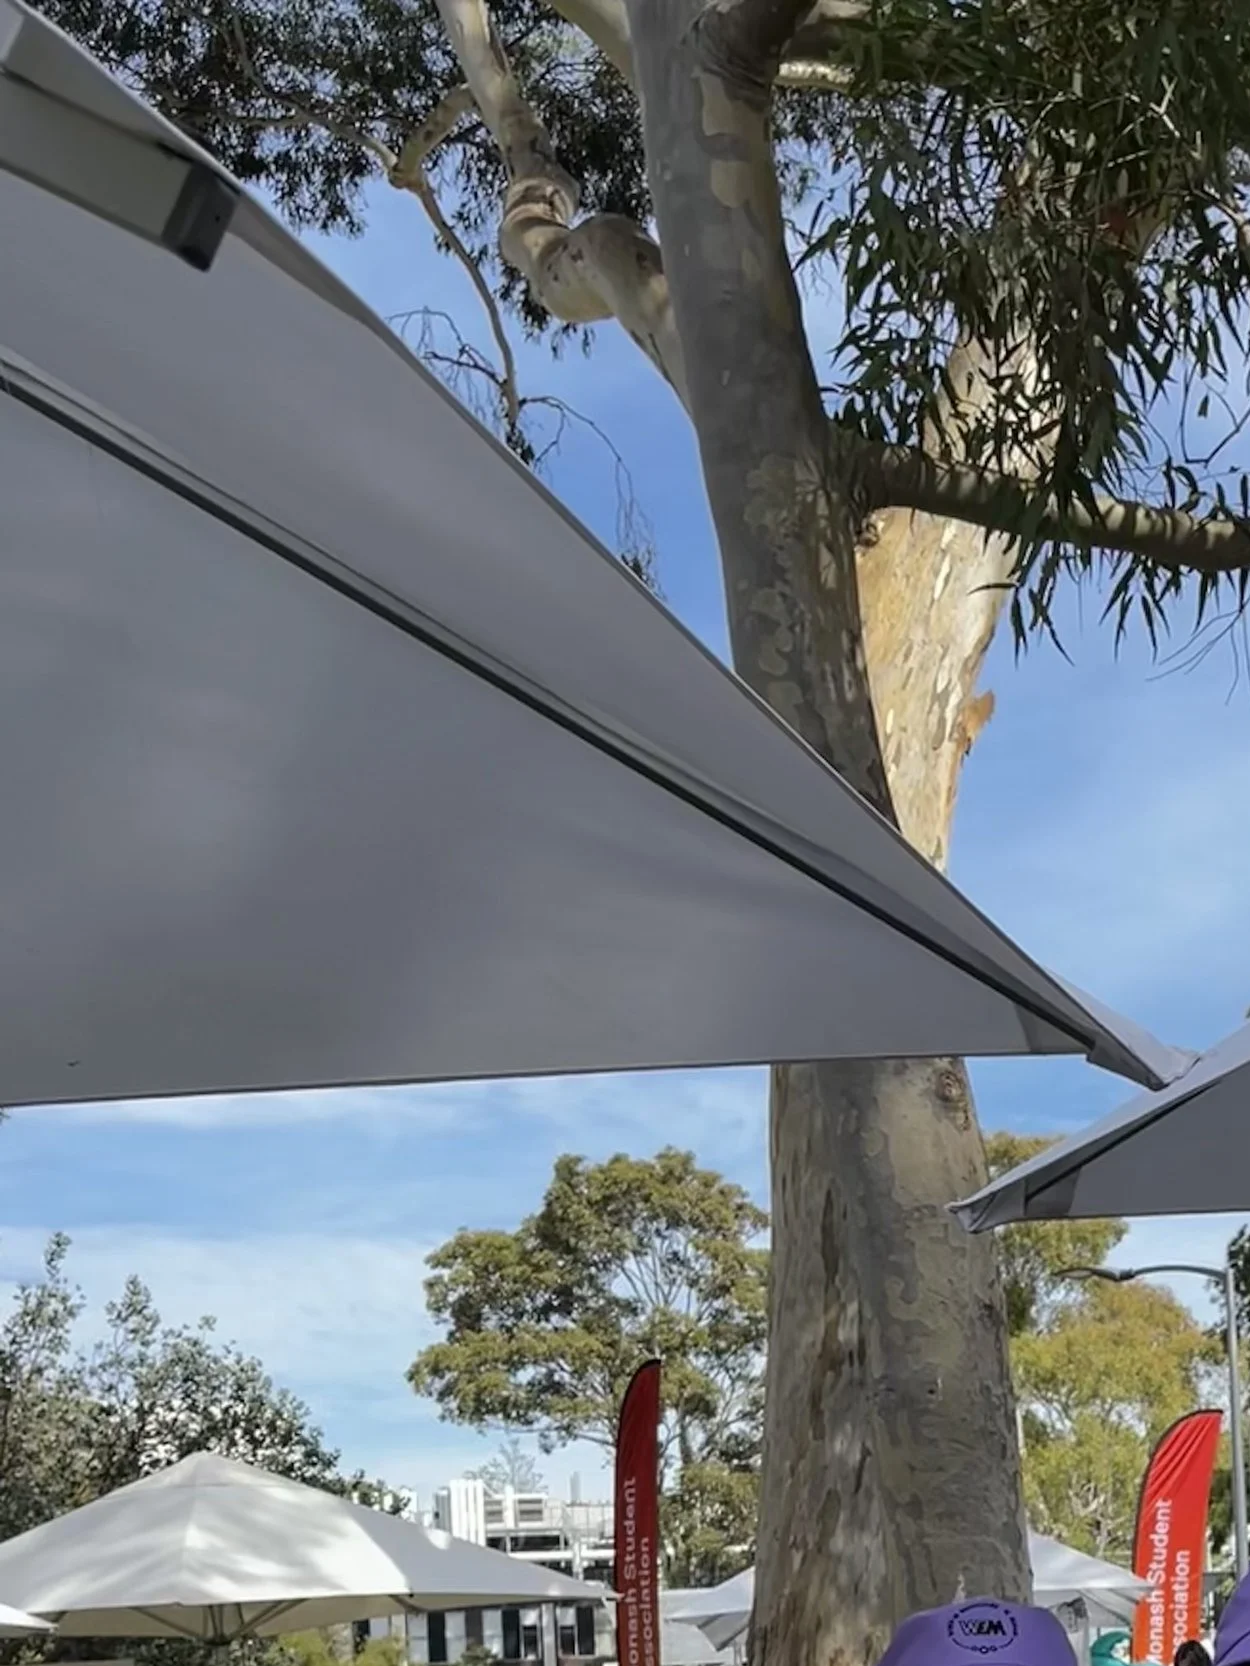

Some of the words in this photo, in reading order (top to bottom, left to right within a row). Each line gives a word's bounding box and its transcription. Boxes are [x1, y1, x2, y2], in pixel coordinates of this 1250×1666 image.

[622, 1476, 637, 1581] Student
[1147, 1498, 1172, 1586] Student
[959, 1619, 1007, 1637] WEM
